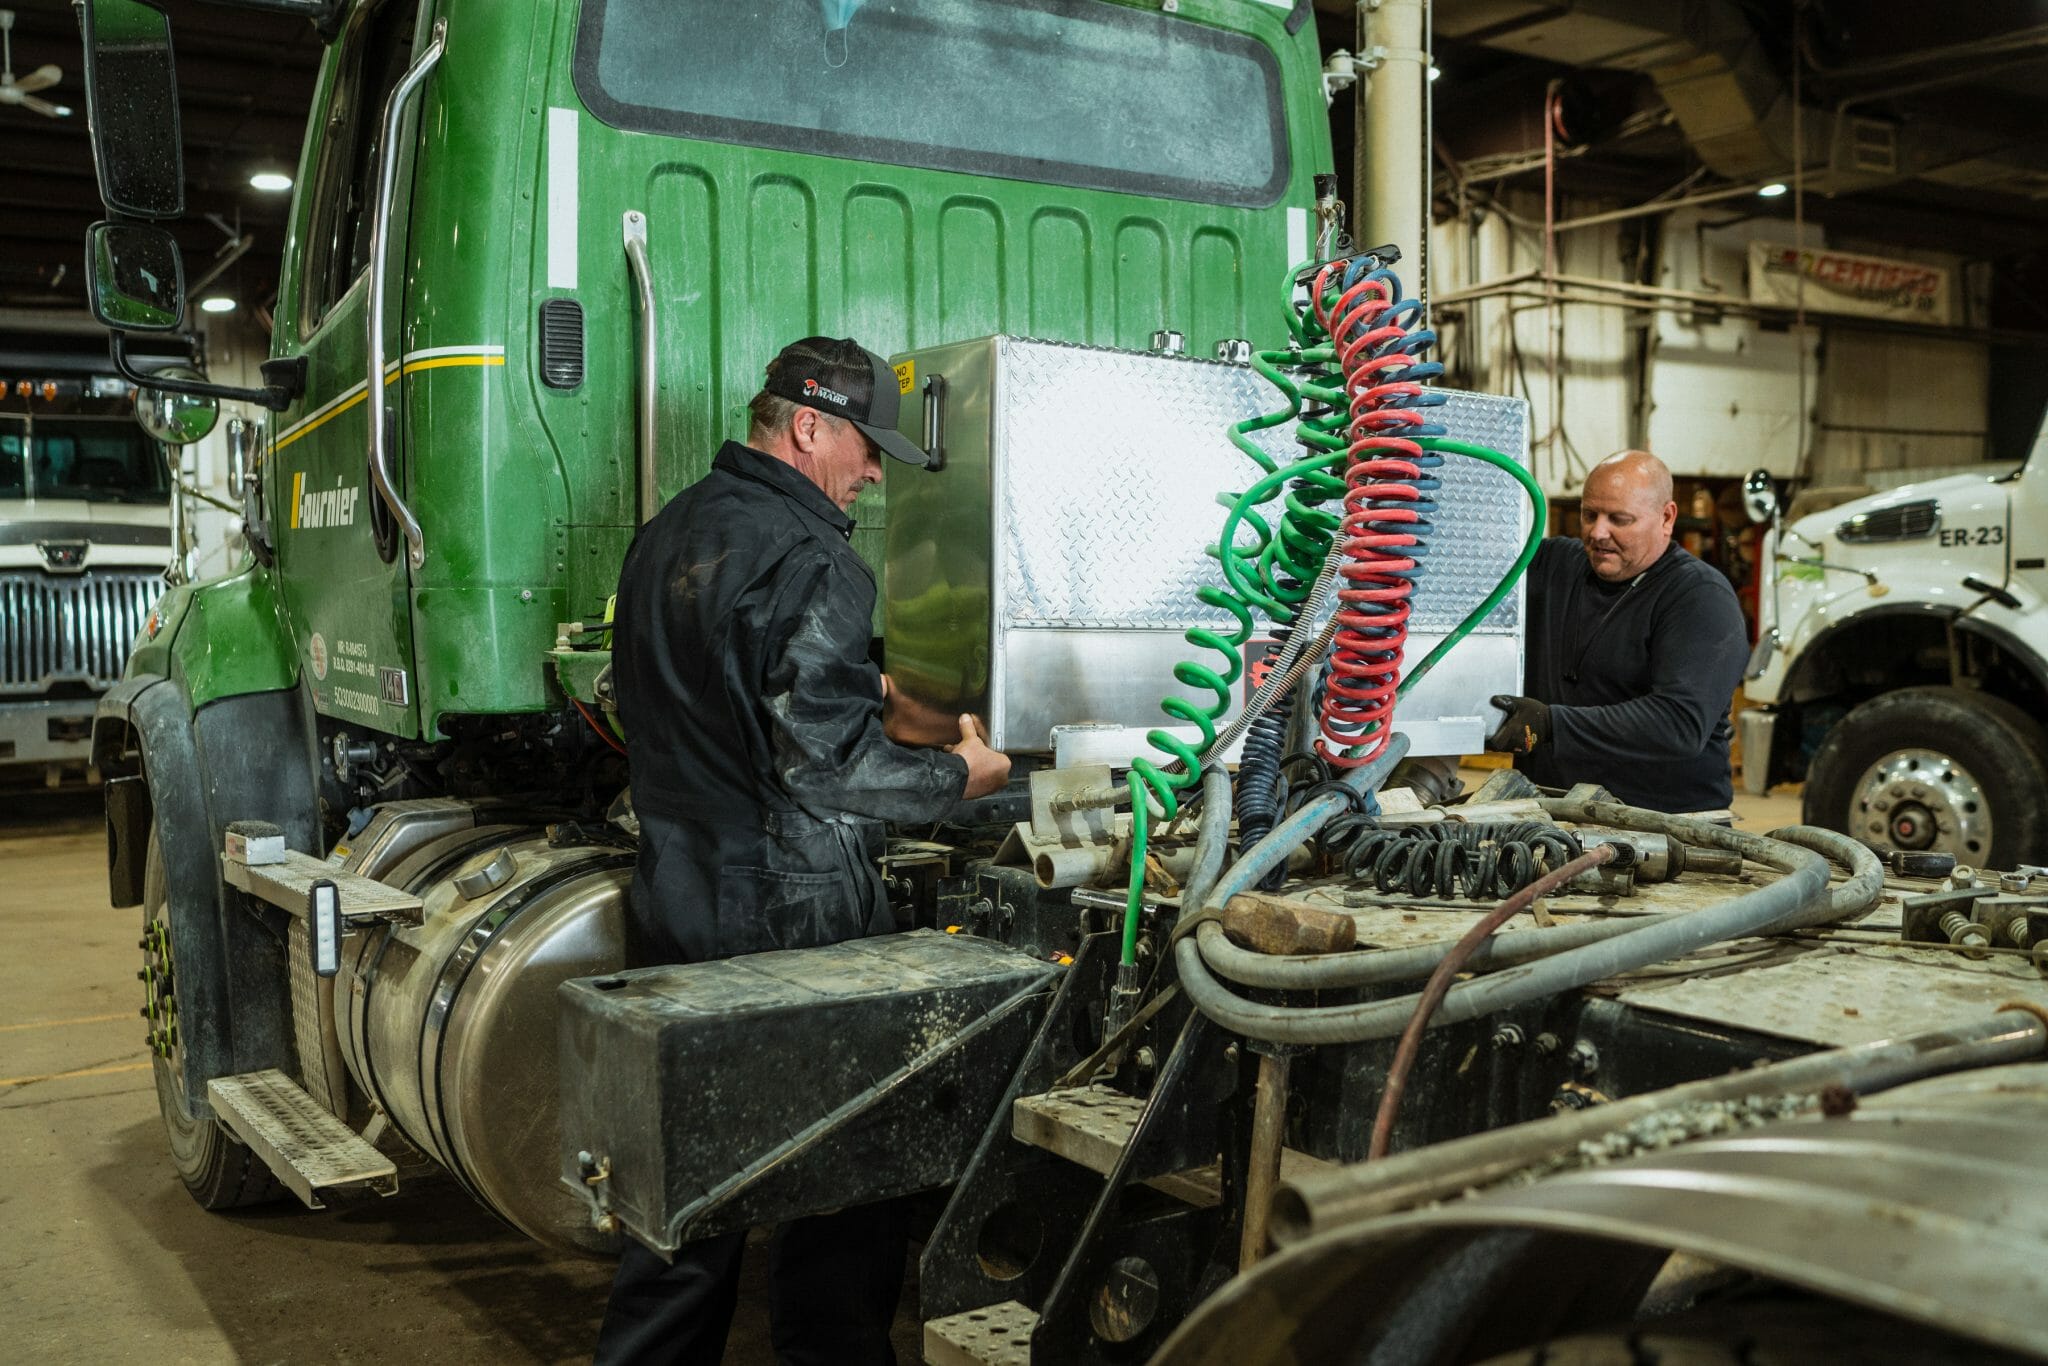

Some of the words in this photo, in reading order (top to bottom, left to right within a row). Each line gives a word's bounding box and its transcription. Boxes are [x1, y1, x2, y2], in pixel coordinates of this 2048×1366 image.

[896, 366, 906, 377] NO
[296, 471, 359, 528] Fournier
[1940, 526, 2003, 547] ER-23
